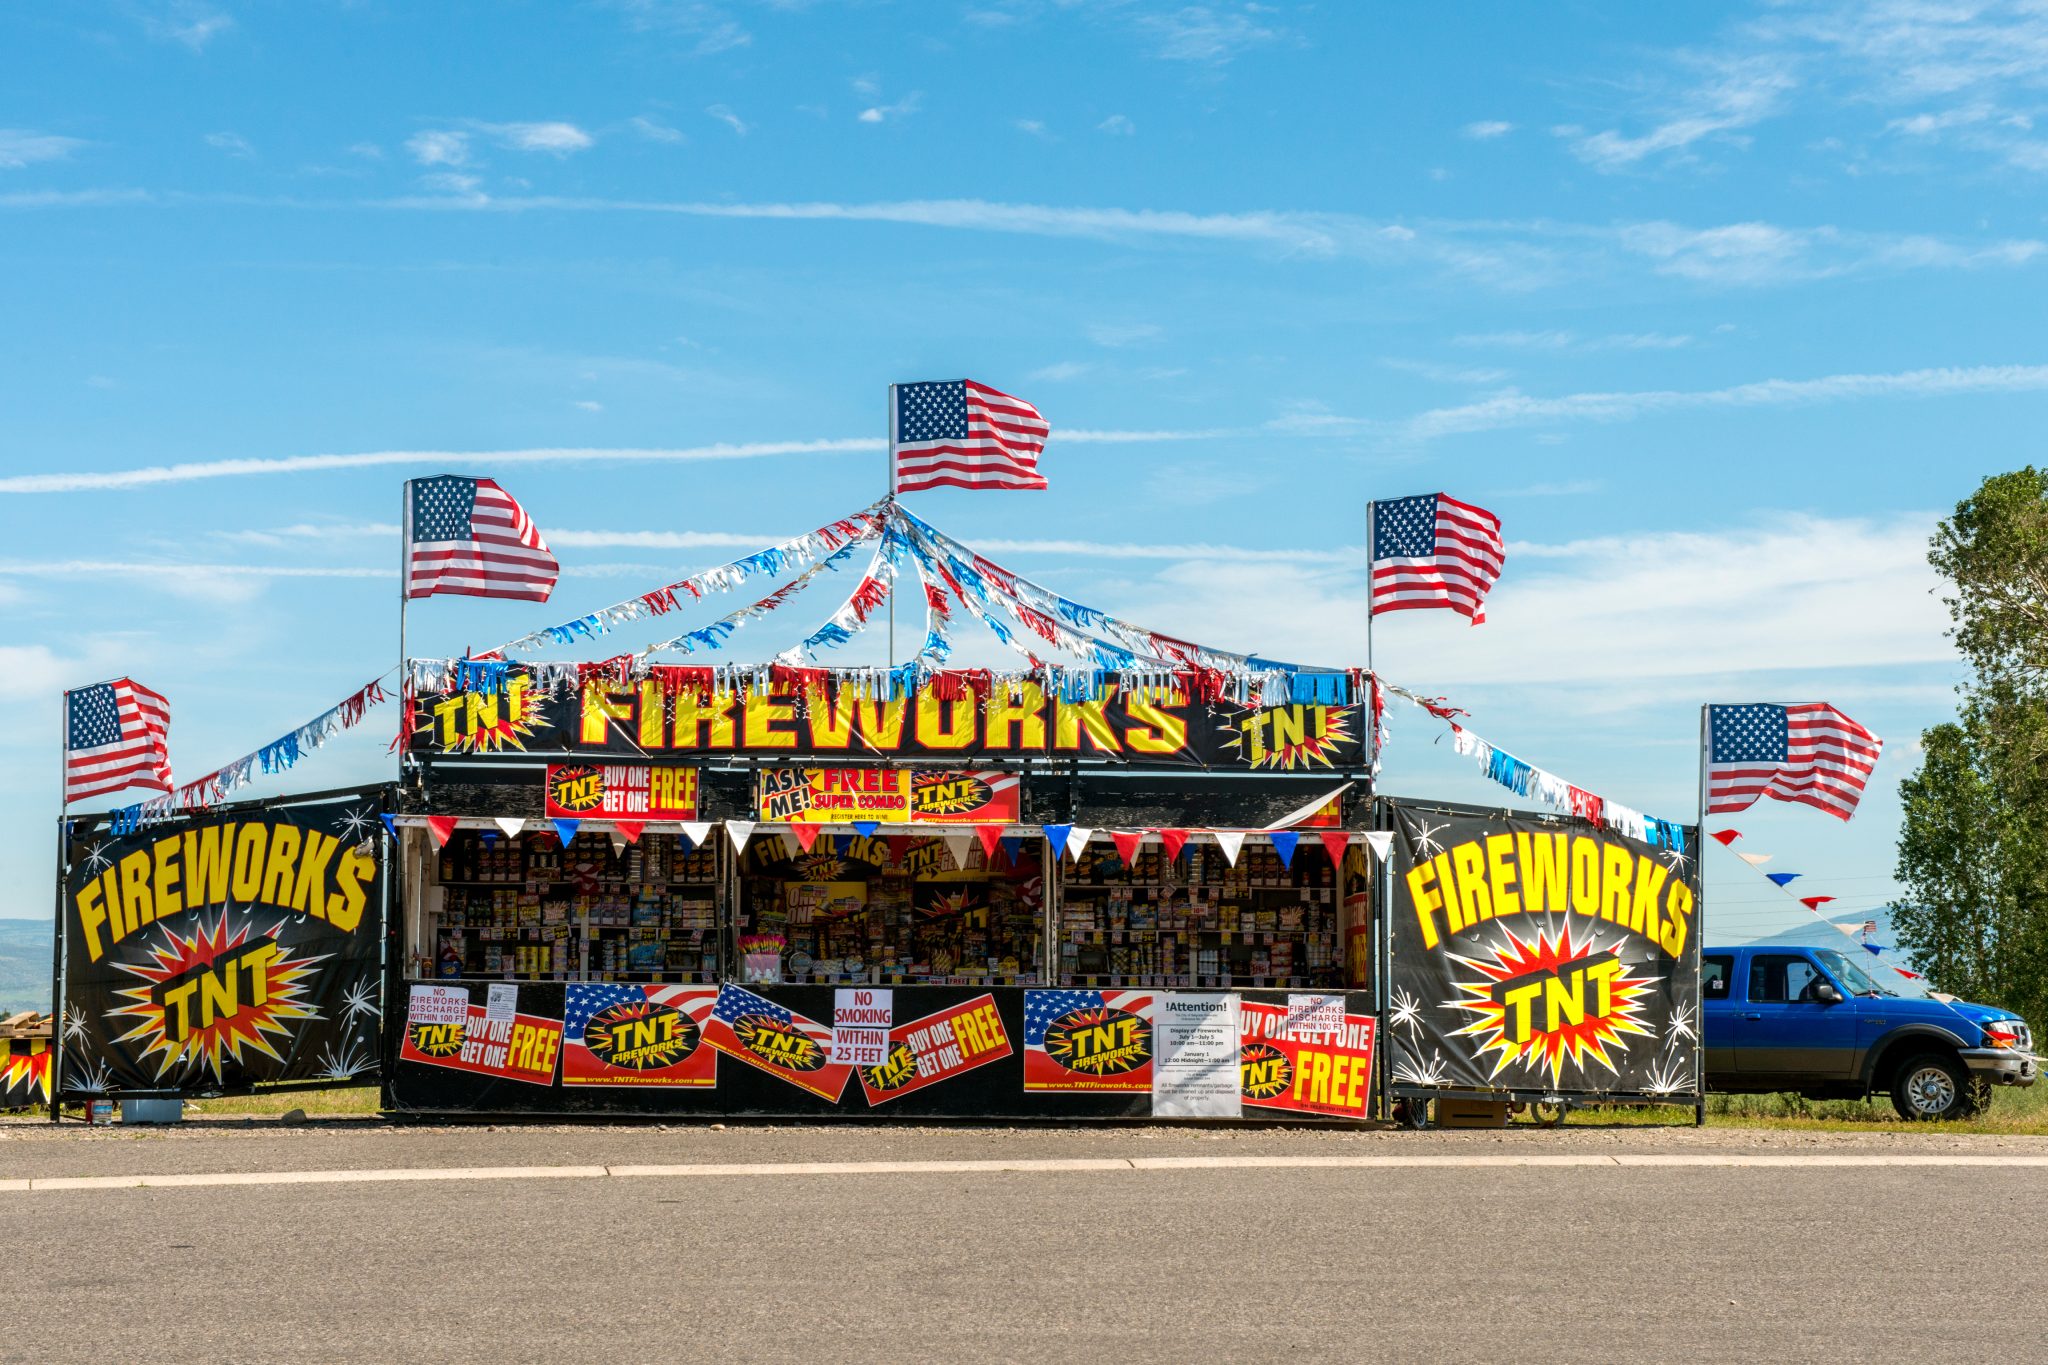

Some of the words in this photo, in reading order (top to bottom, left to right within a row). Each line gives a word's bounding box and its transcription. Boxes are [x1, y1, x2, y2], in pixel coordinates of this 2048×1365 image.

[434, 673, 529, 746] TNT
[580, 678, 1187, 754] FIREWORKS
[1241, 693, 1327, 761] TNT
[558, 774, 599, 804] TNT
[604, 766, 626, 787] BUY
[627, 766, 650, 788] ONE
[651, 767, 696, 809] FREE
[765, 768, 810, 795] ASK
[824, 768, 899, 792] FREE
[603, 790, 625, 812] GET
[627, 791, 649, 812] ONE
[770, 787, 811, 818] ME!
[814, 794, 855, 809] SUPER
[857, 795, 906, 809] COMBO
[918, 779, 974, 804] TNT
[918, 794, 977, 811] FIREWORKS
[908, 842, 942, 872] TNT
[76, 822, 377, 964] FIREWORKS
[1405, 831, 1694, 959] FIREWORKS
[163, 941, 277, 1043] TNT
[410, 996, 467, 1006] FIREWORKS
[433, 988, 445, 996] NO
[854, 991, 872, 1006] NO
[1310, 997, 1322, 1005] NO
[1504, 957, 1621, 1046] TNT
[409, 1013, 437, 1022] WITHIN
[440, 1014, 453, 1022] 100
[410, 1005, 466, 1014] DISCHARGE
[834, 1008, 891, 1024] SMOKING
[1165, 1002, 1227, 1012] !Attention!
[1289, 1005, 1344, 1014] FIREWORKS
[1289, 1014, 1344, 1023] DISCHARGE
[417, 1024, 462, 1046] TNT
[465, 1015, 489, 1040] BUY
[489, 1020, 513, 1043] ONE
[612, 1011, 679, 1053] TNT
[836, 1029, 884, 1046] WITHIN
[907, 1027, 932, 1054] BUY
[929, 1019, 955, 1046] ONE
[951, 1003, 1006, 1058] FREE
[1071, 1017, 1137, 1058] TNT
[1241, 1010, 1262, 1037] UY
[1336, 1022, 1370, 1051] ONE
[1289, 1022, 1317, 1030] WITHIN
[460, 1040, 484, 1065] GET
[483, 1044, 509, 1069] ONE
[507, 1023, 559, 1073] FREE
[611, 1037, 683, 1064] FIREWORKS
[750, 1043, 810, 1063] FIREWORKS
[756, 1028, 813, 1055] TNT
[836, 1047, 851, 1061] 25
[854, 1047, 883, 1063] FEET
[727, 1048, 810, 1089] www.TNTFireworks.com
[870, 1045, 908, 1087] TNT
[916, 1051, 940, 1078] GET
[939, 1043, 964, 1070] ONE
[1072, 1043, 1142, 1070] FIREWORKS
[586, 1076, 693, 1084] www.TNTFireworks.com
[1048, 1081, 1152, 1089] www.TNTFireworks.com
[1241, 1057, 1284, 1087] TNT
[1293, 1050, 1367, 1108] FREE
